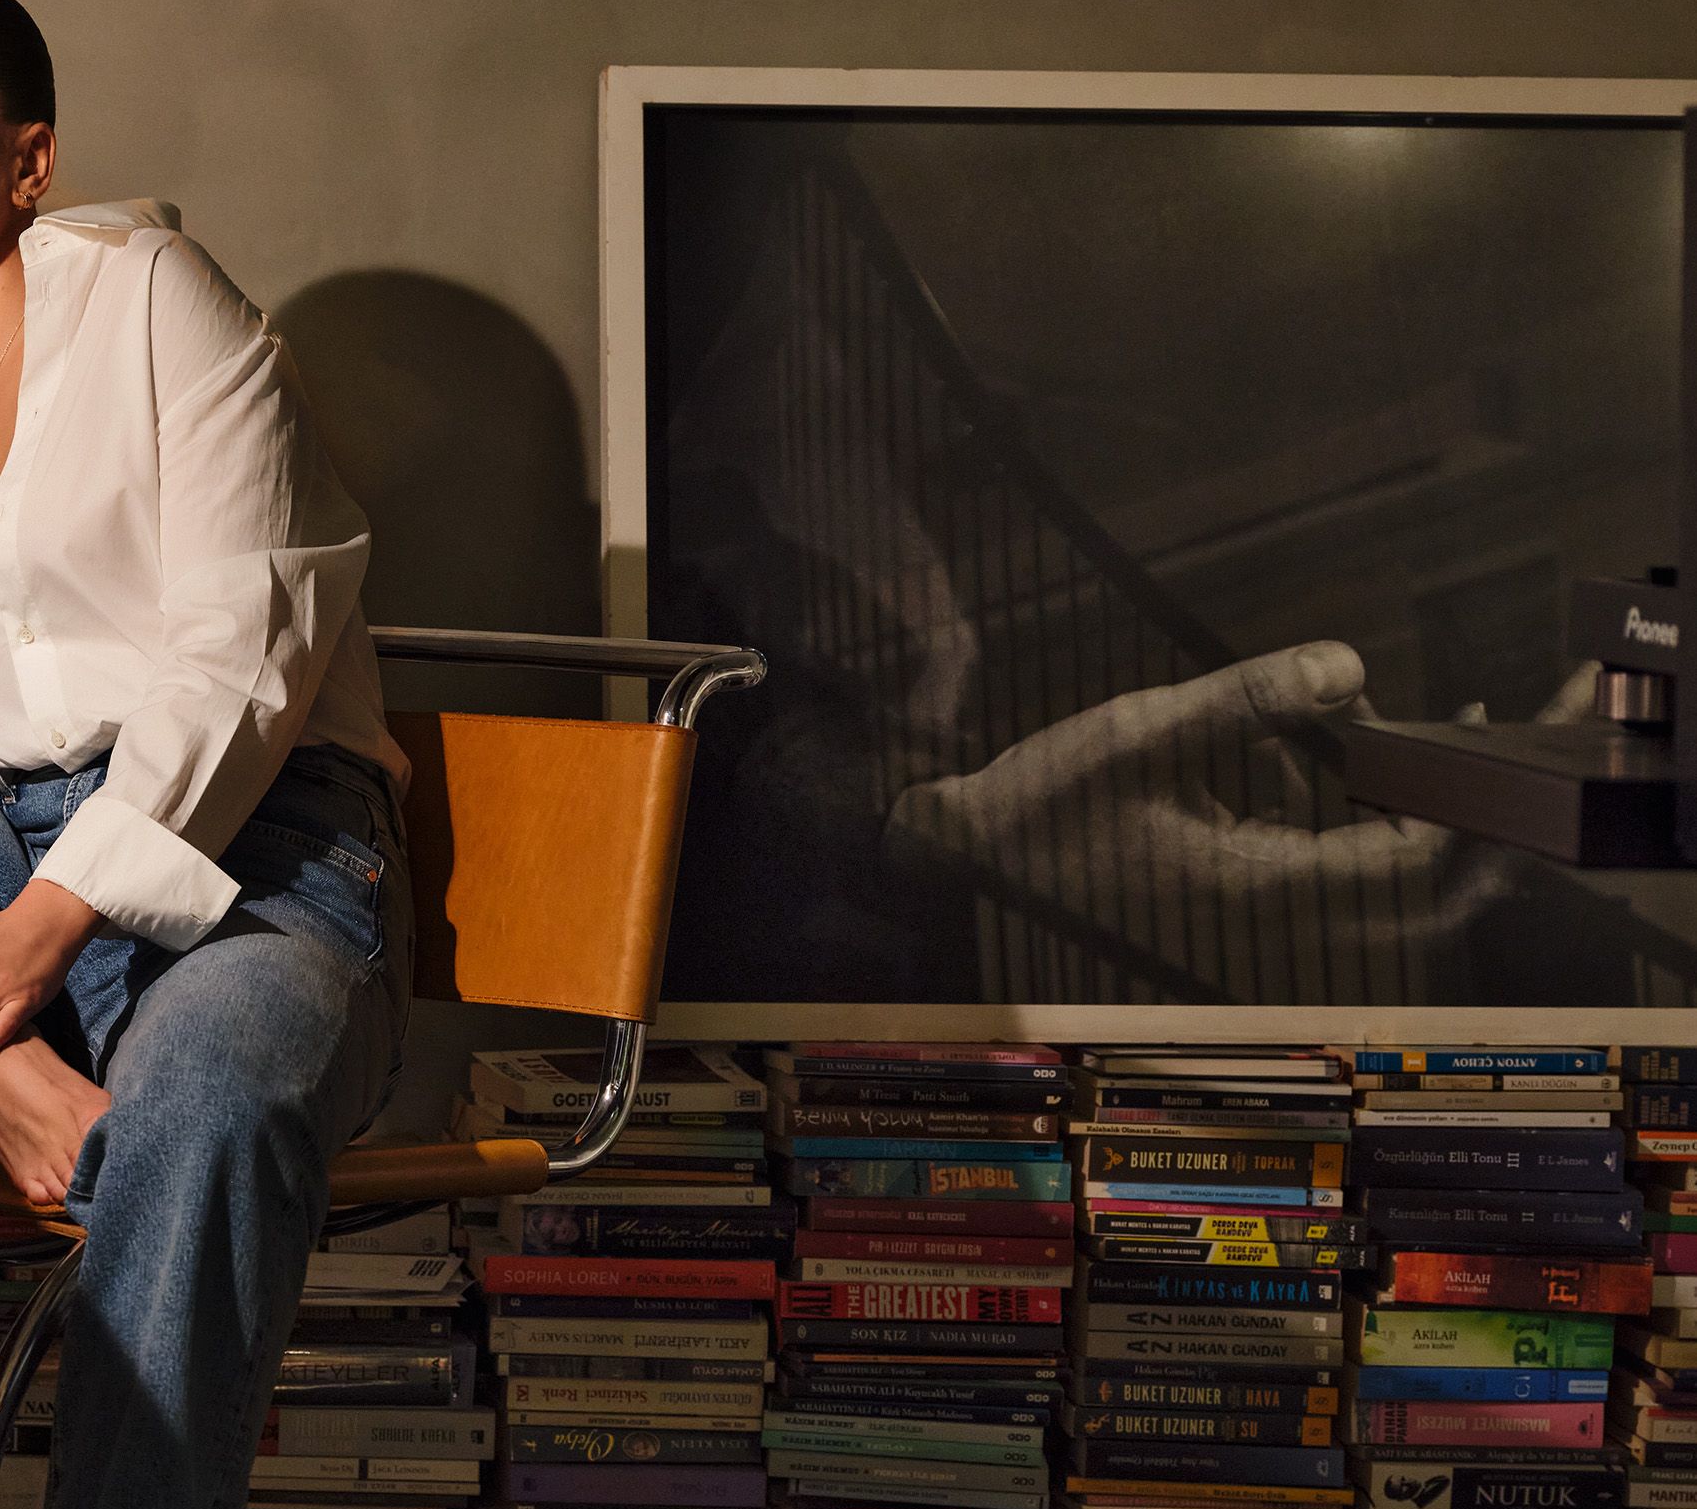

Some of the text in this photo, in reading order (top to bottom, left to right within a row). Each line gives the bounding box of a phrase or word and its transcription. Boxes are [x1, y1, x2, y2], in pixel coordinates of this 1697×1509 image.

[1623, 605, 1680, 649] Pionee
[1451, 1056, 1539, 1069] ANTON ÇEHOV
[552, 1092, 672, 1108] GOET AUST
[859, 1088, 970, 1103] M Patti Smith
[1161, 1095, 1270, 1108] Mahrum EREN ABAKA
[928, 1112, 955, 1122] Aamir
[1652, 1140, 1691, 1154] Zeynep
[1129, 1151, 1295, 1171] BUKET UZUNER TOPRAK
[1373, 1148, 1590, 1168] Özgürlüğün Elli Tonu III E L James
[927, 1161, 1019, 1195] İSTANBUL
[1388, 1207, 1605, 1225] Karanlığın Elli Tonu II E L James
[1211, 1220, 1260, 1230] DERDE DEVA
[1222, 1245, 1269, 1255] DERDE DEVA
[503, 1269, 562, 1285] SOPHIA
[568, 1270, 620, 1285] LOREN
[705, 1273, 738, 1286] YARIN
[845, 1265, 871, 1276] YOLA
[873, 1266, 905, 1278] ÇIKMA
[1444, 1268, 1491, 1285] AKİLAH
[1093, 1278, 1310, 1302] Hakan KAYRA
[1445, 1284, 1489, 1294] azra kohen
[847, 1282, 971, 1321] THE GREATEST
[978, 1289, 996, 1320] MY
[1178, 1313, 1226, 1328] HAKAN
[528, 1331, 570, 1343] SAKEY
[572, 1331, 624, 1345] MARCUS
[850, 1327, 1017, 1344] SON KIZ NADIA MURAD
[1412, 1327, 1458, 1341] AKİLAH
[1178, 1342, 1227, 1356] HAKAN
[1413, 1341, 1455, 1351] azra kohen
[281, 1364, 409, 1381] KTEYLLER
[542, 1388, 578, 1403] Renk
[586, 1389, 648, 1404] Sekizinci
[713, 1392, 752, 1406] GÜLTEN
[1123, 1383, 1281, 1407] BUKET UZUNER HAVA
[1115, 1415, 1258, 1437] BUKET UZUNER SU
[1383, 1401, 1396, 1445] ORHAN
[1395, 1401, 1409, 1445] PAMUK
[1473, 1416, 1551, 1433] MASUMİYET
[553, 1429, 614, 1462] Ofelya
[670, 1438, 713, 1450] KLEIN
[1474, 1485, 1578, 1508] NUTUK
